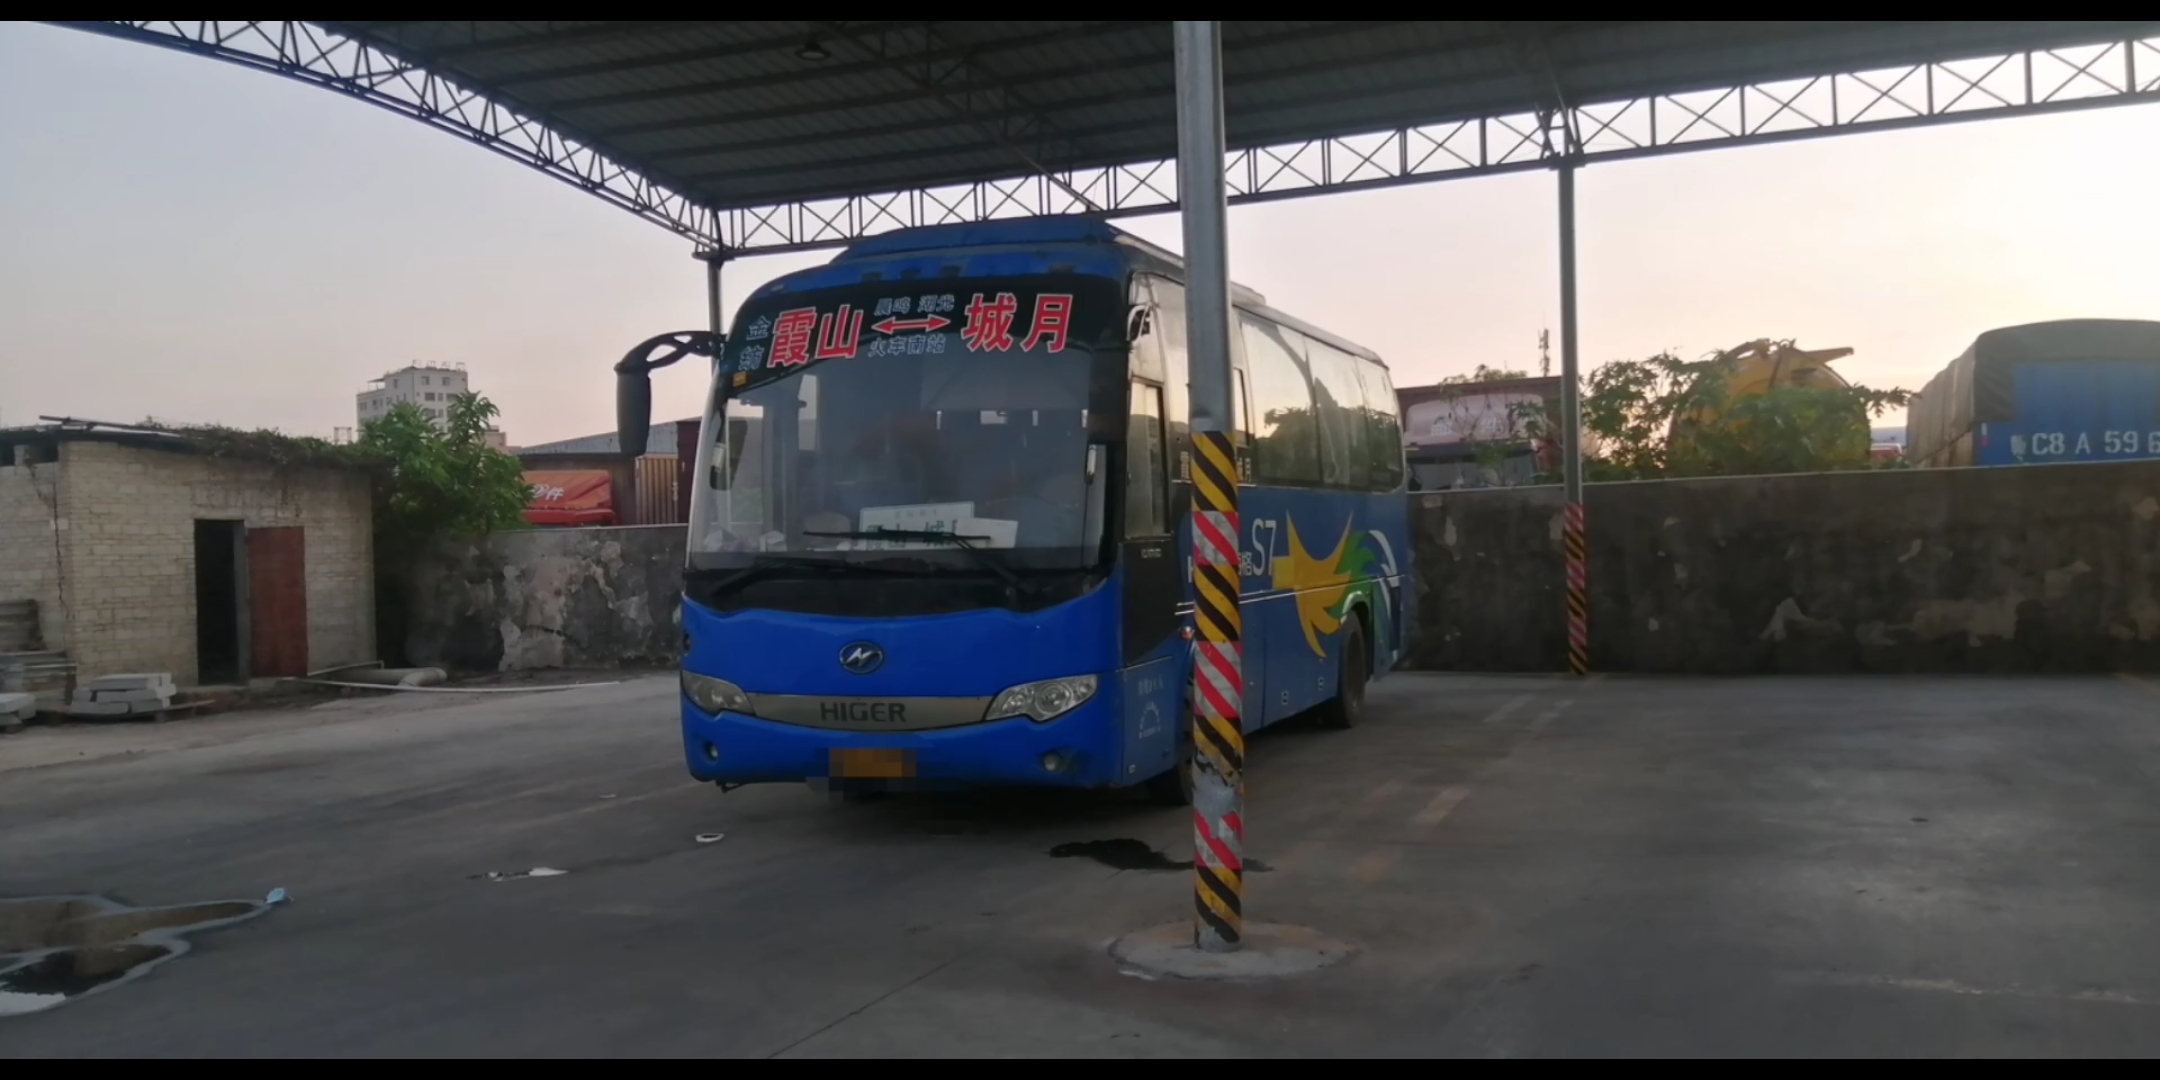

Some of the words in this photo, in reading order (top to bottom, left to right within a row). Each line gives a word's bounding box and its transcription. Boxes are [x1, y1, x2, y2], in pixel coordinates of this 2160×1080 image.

[767, 304, 864, 368] 霞山
[961, 292, 1073, 354] 城月
[867, 333, 947, 358] 火车南站
[820, 702, 906, 722] HIGER
